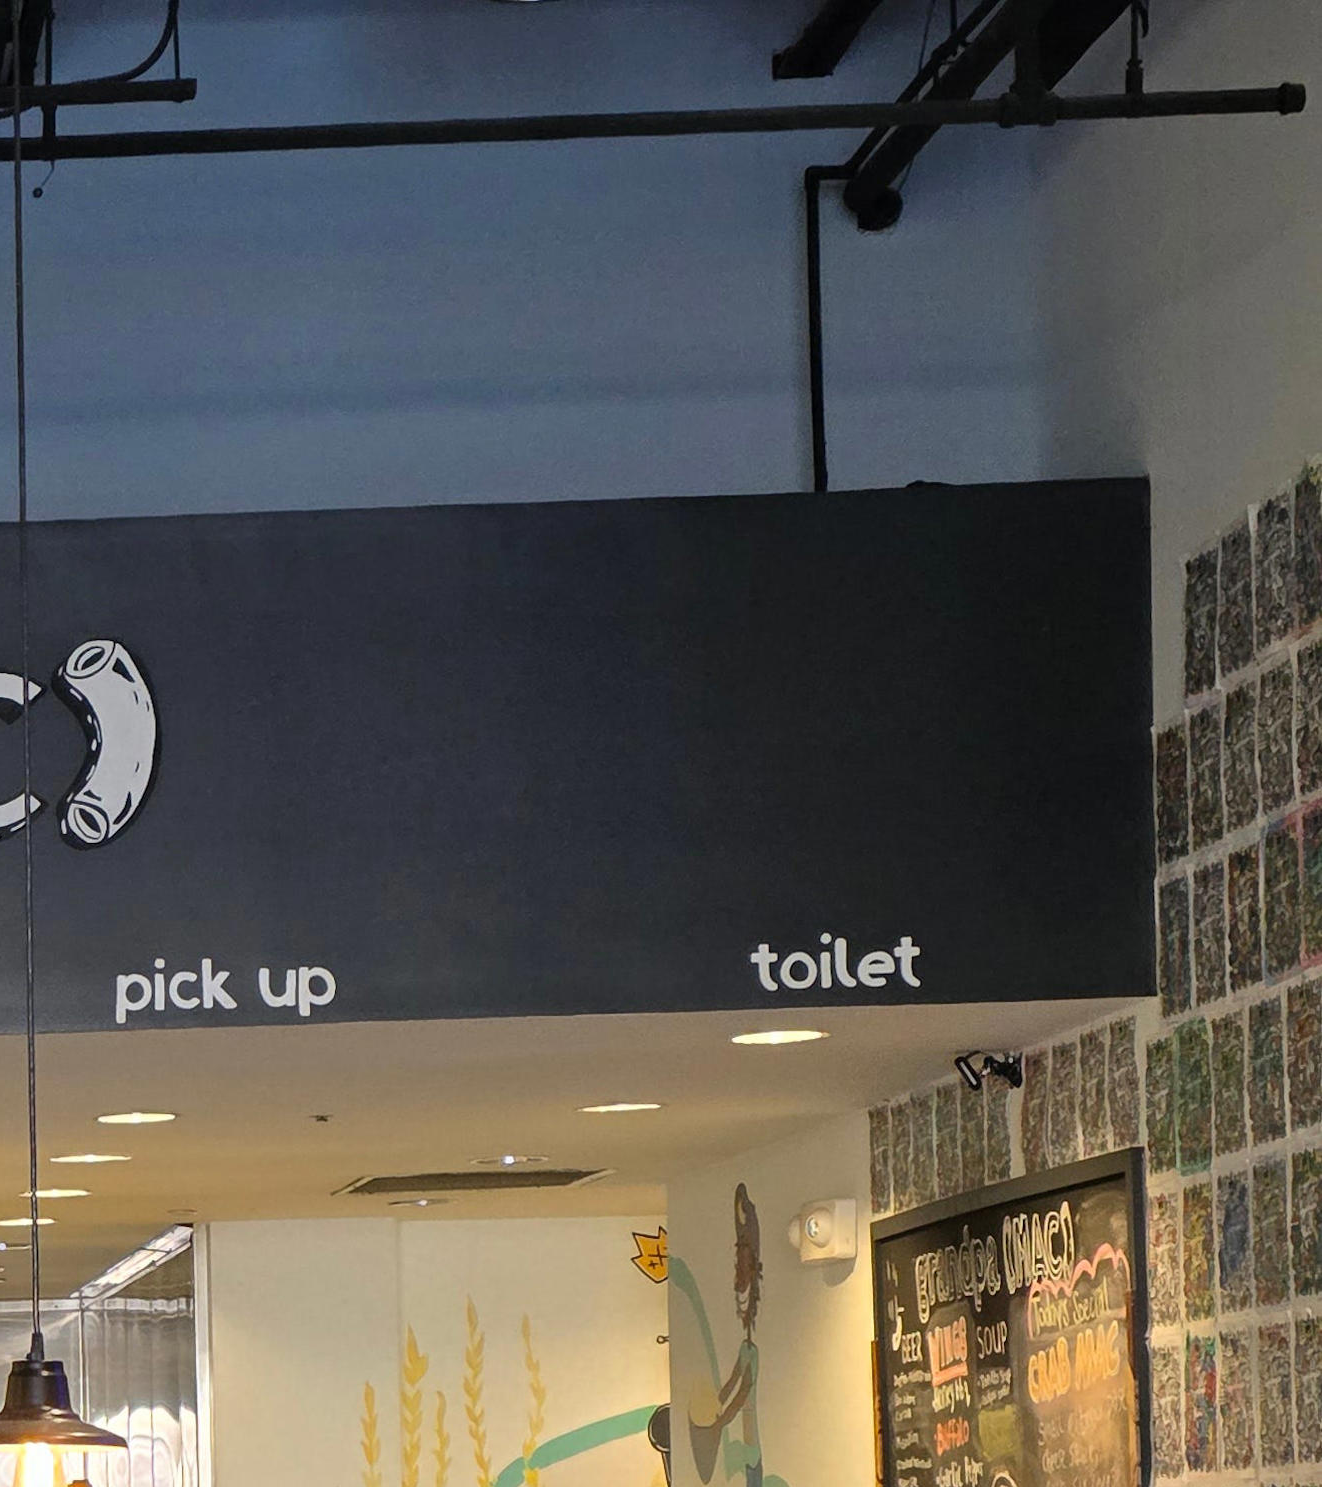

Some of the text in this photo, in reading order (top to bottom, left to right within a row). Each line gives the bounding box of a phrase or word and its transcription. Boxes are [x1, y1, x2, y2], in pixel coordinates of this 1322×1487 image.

[115, 957, 337, 1024] pick up
[750, 932, 921, 992] toilet
[977, 1320, 1009, 1359] SOUP
